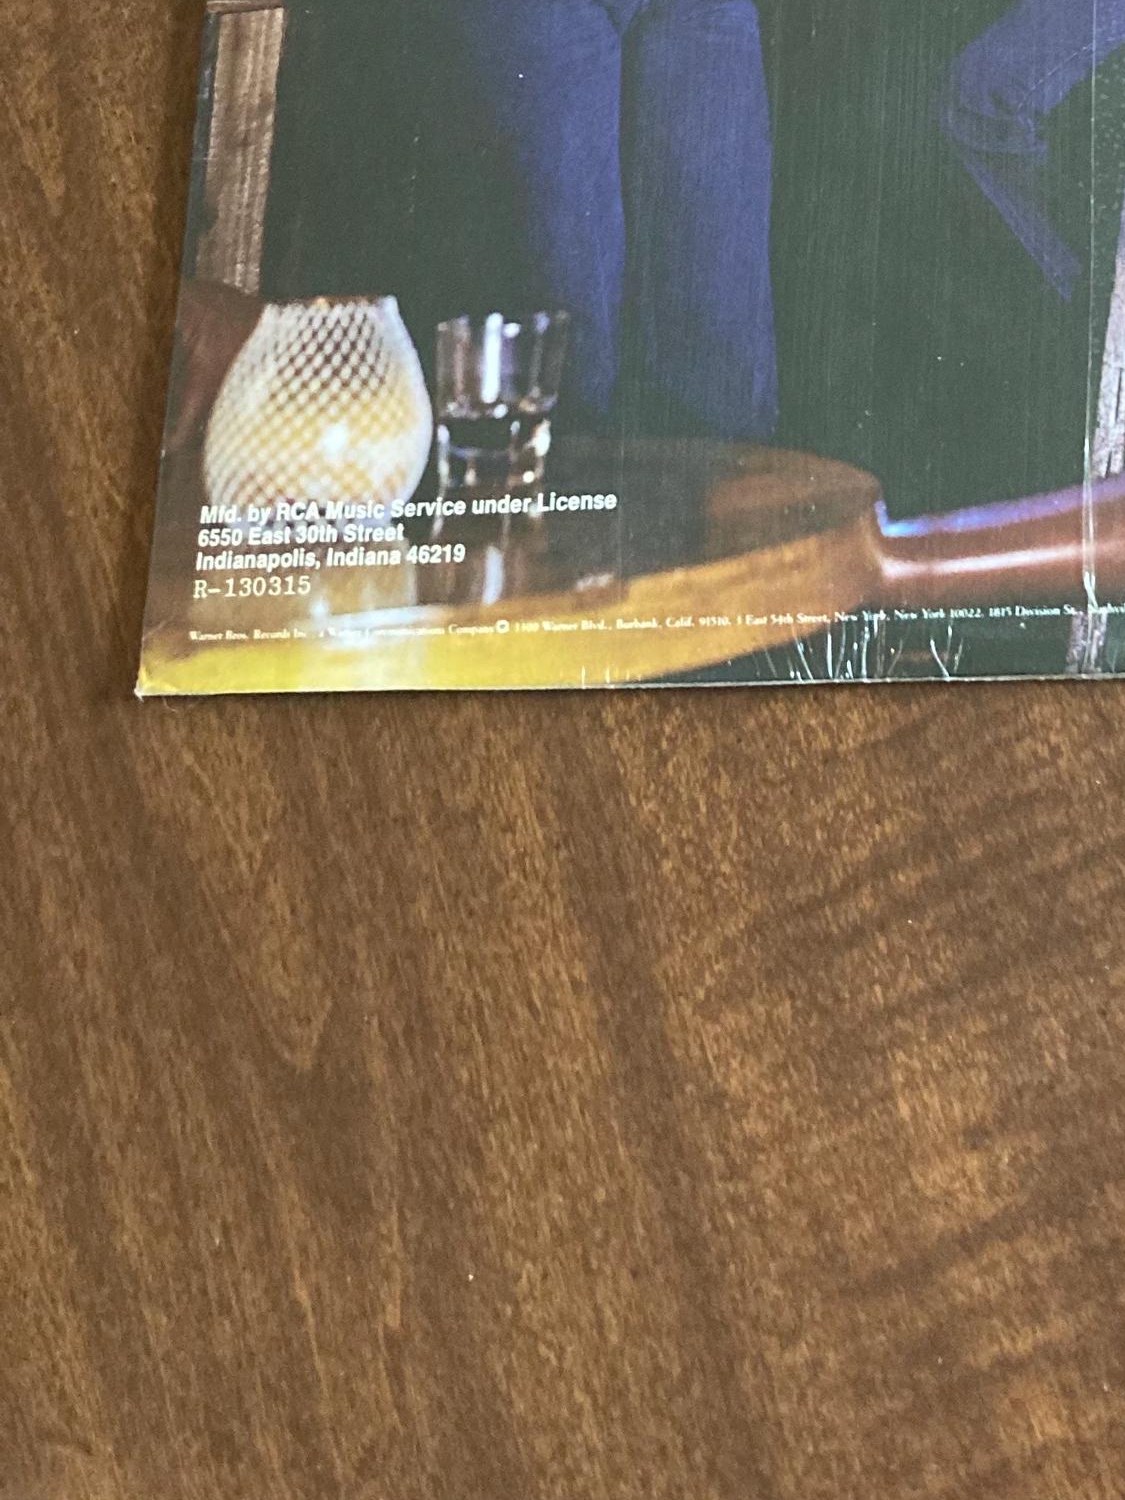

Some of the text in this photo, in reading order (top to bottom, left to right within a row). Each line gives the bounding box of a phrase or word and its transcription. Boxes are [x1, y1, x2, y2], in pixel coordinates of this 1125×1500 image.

[200, 492, 619, 526] Mfd. by RCA Music Service under License
[198, 523, 405, 548] 6550 East 30th Street
[195, 543, 466, 572] Indianapolis, Indiana 46219
[192, 575, 312, 600] R-130315
